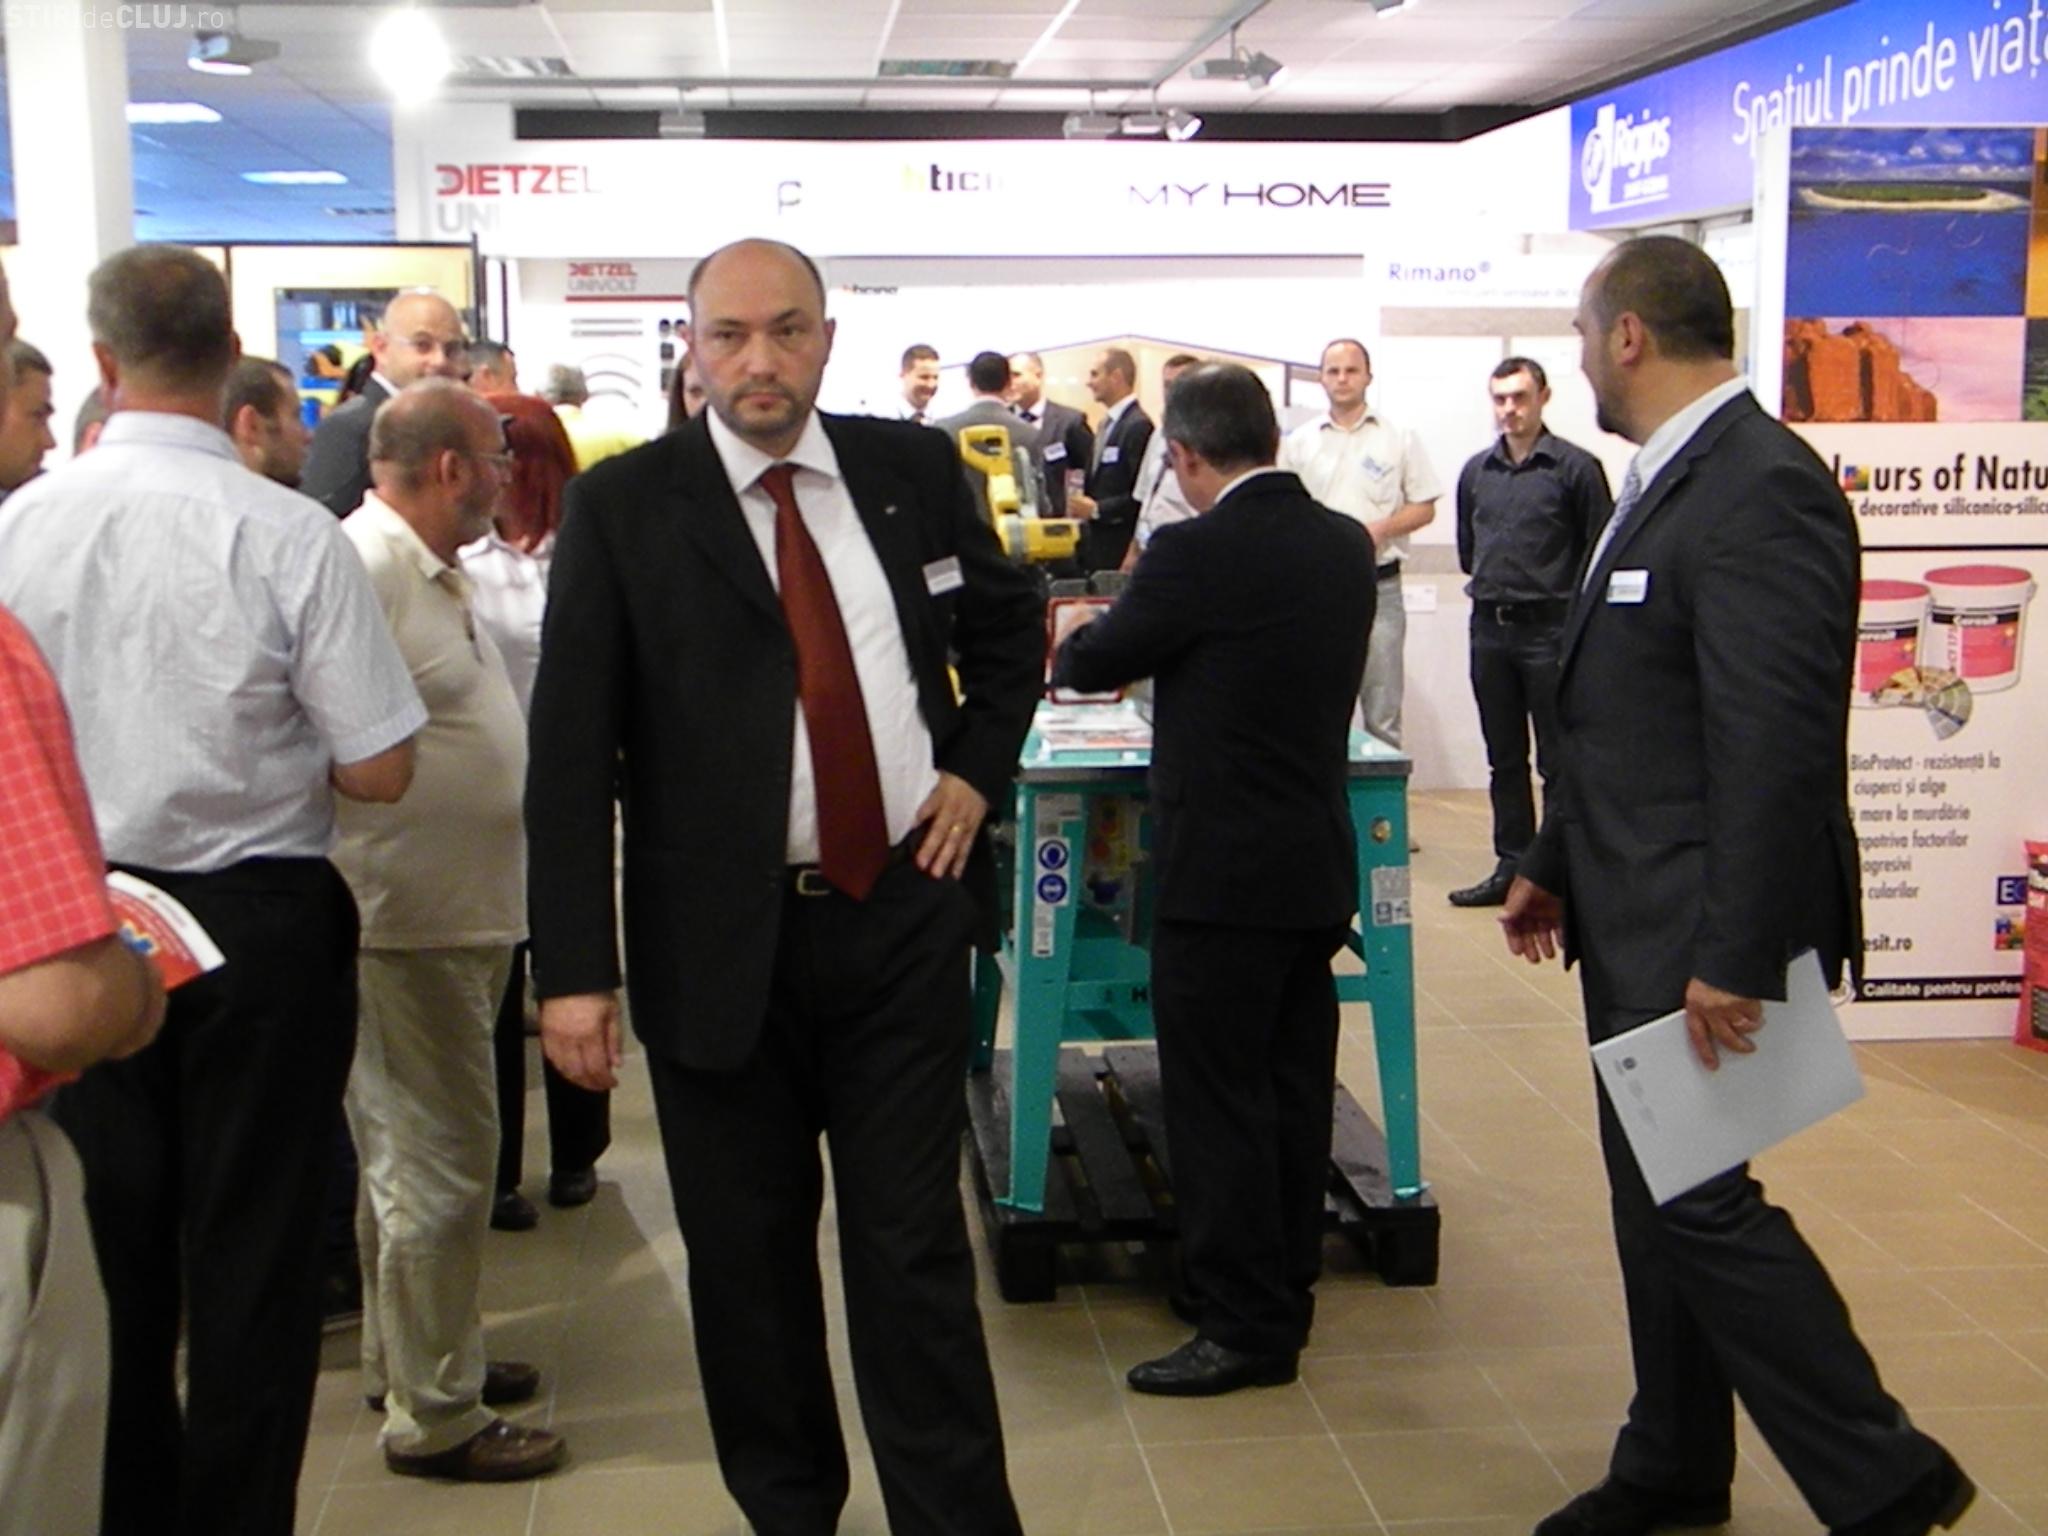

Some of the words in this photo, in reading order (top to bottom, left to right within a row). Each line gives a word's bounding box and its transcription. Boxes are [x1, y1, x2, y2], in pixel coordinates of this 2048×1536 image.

[1842, 21, 1957, 125] prinde
[436, 164, 602, 196] DIETZEL
[1130, 184, 1209, 206] MY
[1223, 182, 1391, 208] HOME
[1934, 453, 1965, 491] of
[1976, 455, 2048, 491] Natu
[1860, 498, 1938, 516] decorative
[1854, 779, 1902, 798] ciuperci
[1919, 776, 1947, 798] alge
[1860, 809, 1893, 821] mare
[1897, 804, 1908, 821] la
[1912, 829, 1968, 848] factorilor
[1868, 881, 1920, 899] culorilor
[1863, 982, 1921, 997] Calitate
[1923, 982, 1973, 997] pentru
